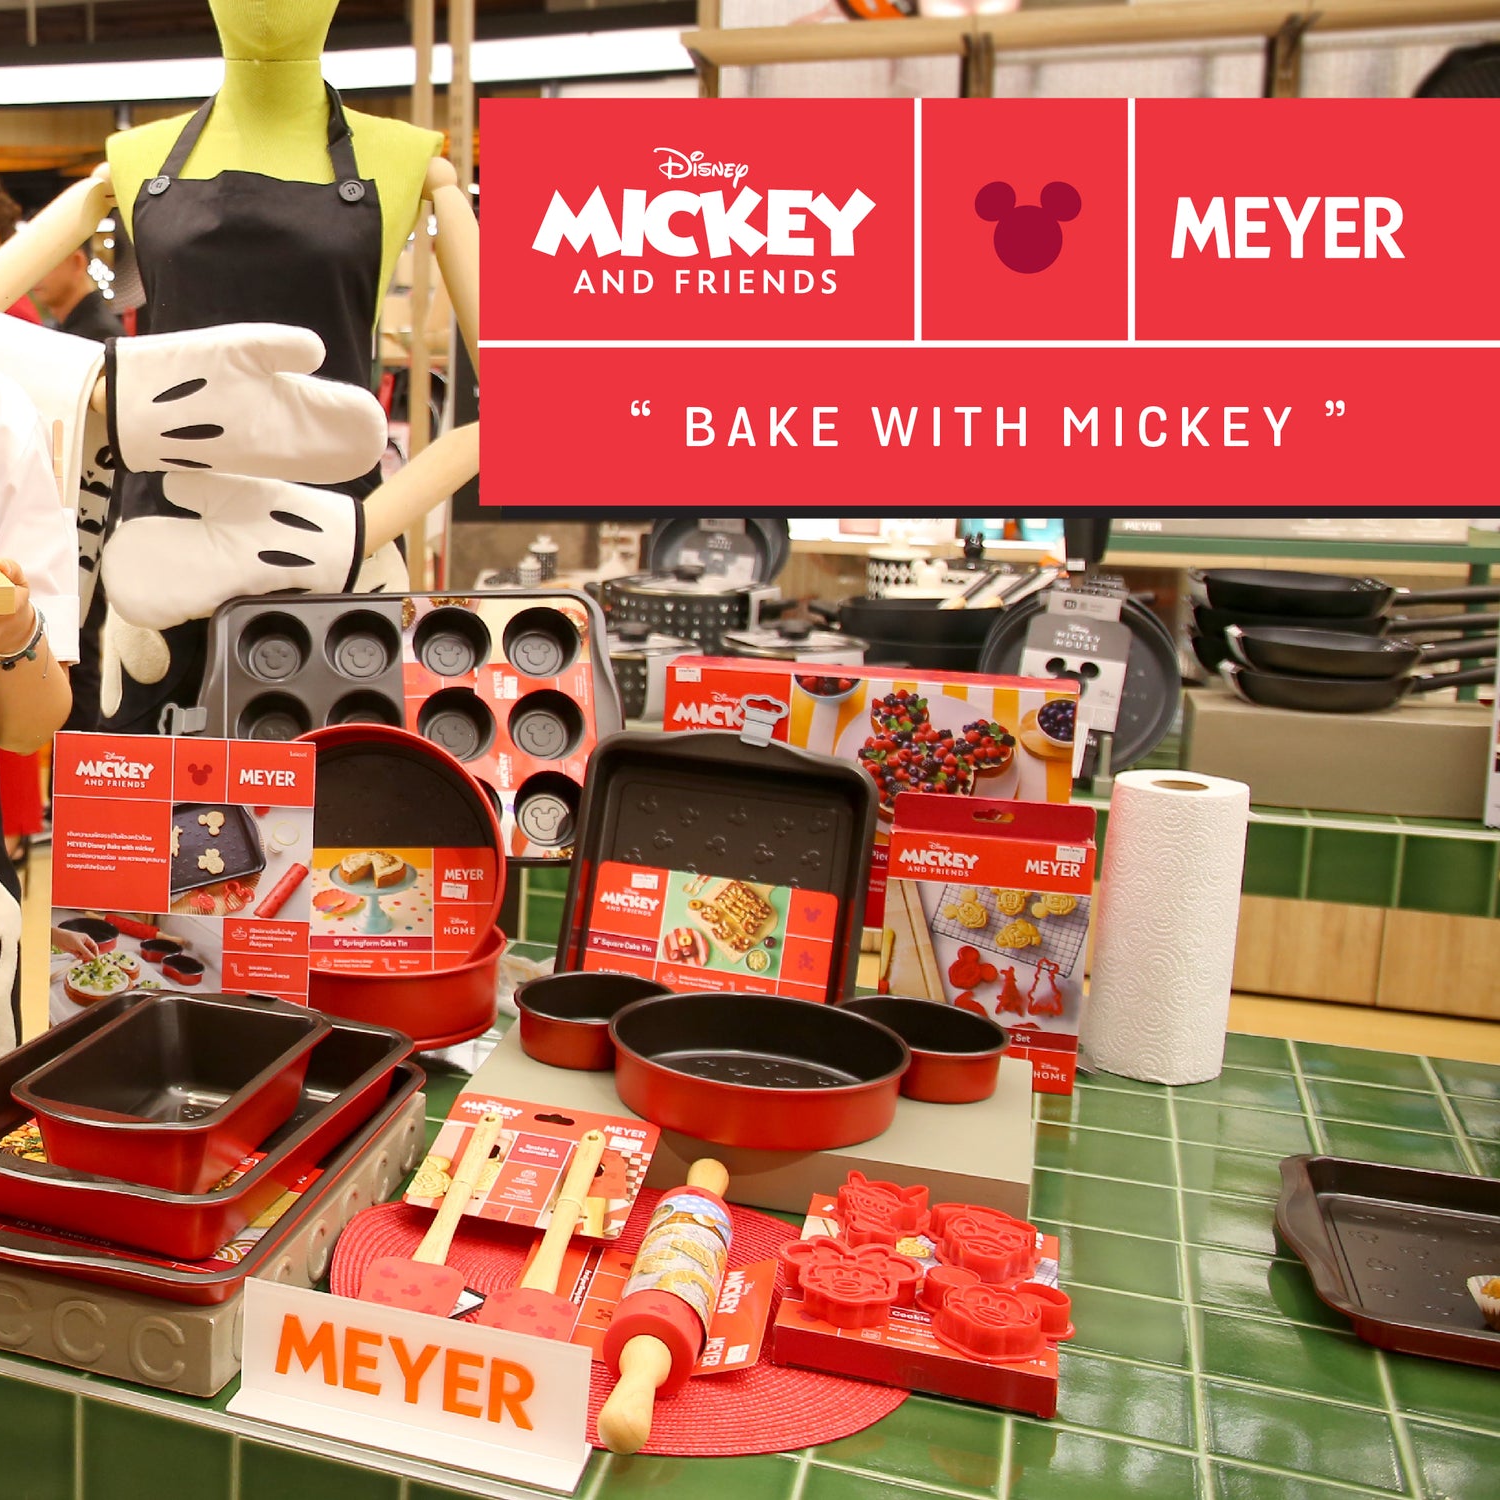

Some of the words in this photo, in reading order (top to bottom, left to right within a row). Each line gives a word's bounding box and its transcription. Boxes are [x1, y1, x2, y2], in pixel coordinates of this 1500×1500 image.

[1055, 631, 1101, 643] MICKEY
[1054, 639, 1099, 652] MOUSE
[672, 701, 745, 728] MICK
[75, 759, 155, 781] MICKEY
[239, 768, 296, 787] MEYER
[84, 778, 104, 787] AND
[107, 780, 147, 789] FRIENDS
[899, 848, 979, 870] MICKEY
[444, 868, 484, 881] MEYER
[907, 866, 927, 874] AND
[930, 867, 970, 877] FRIENDS
[1025, 859, 1081, 878] MEYER
[600, 891, 660, 912] MICKEY
[443, 926, 476, 936] HOME
[342, 939, 380, 949] Springform
[379, 939, 397, 947] Cake
[397, 939, 408, 947] Tin
[601, 938, 626, 950] Square
[624, 941, 641, 952] Cake
[640, 942, 652, 953] Tin
[1015, 1032, 1031, 1043] Set
[1033, 1071, 1067, 1082] HOME
[603, 1124, 647, 1139] MEYER
[717, 1270, 745, 1314] MICKEY
[891, 1310, 931, 1323] Cookie
[701, 1336, 726, 1368] MEYER
[274, 1312, 536, 1432] MEYER
